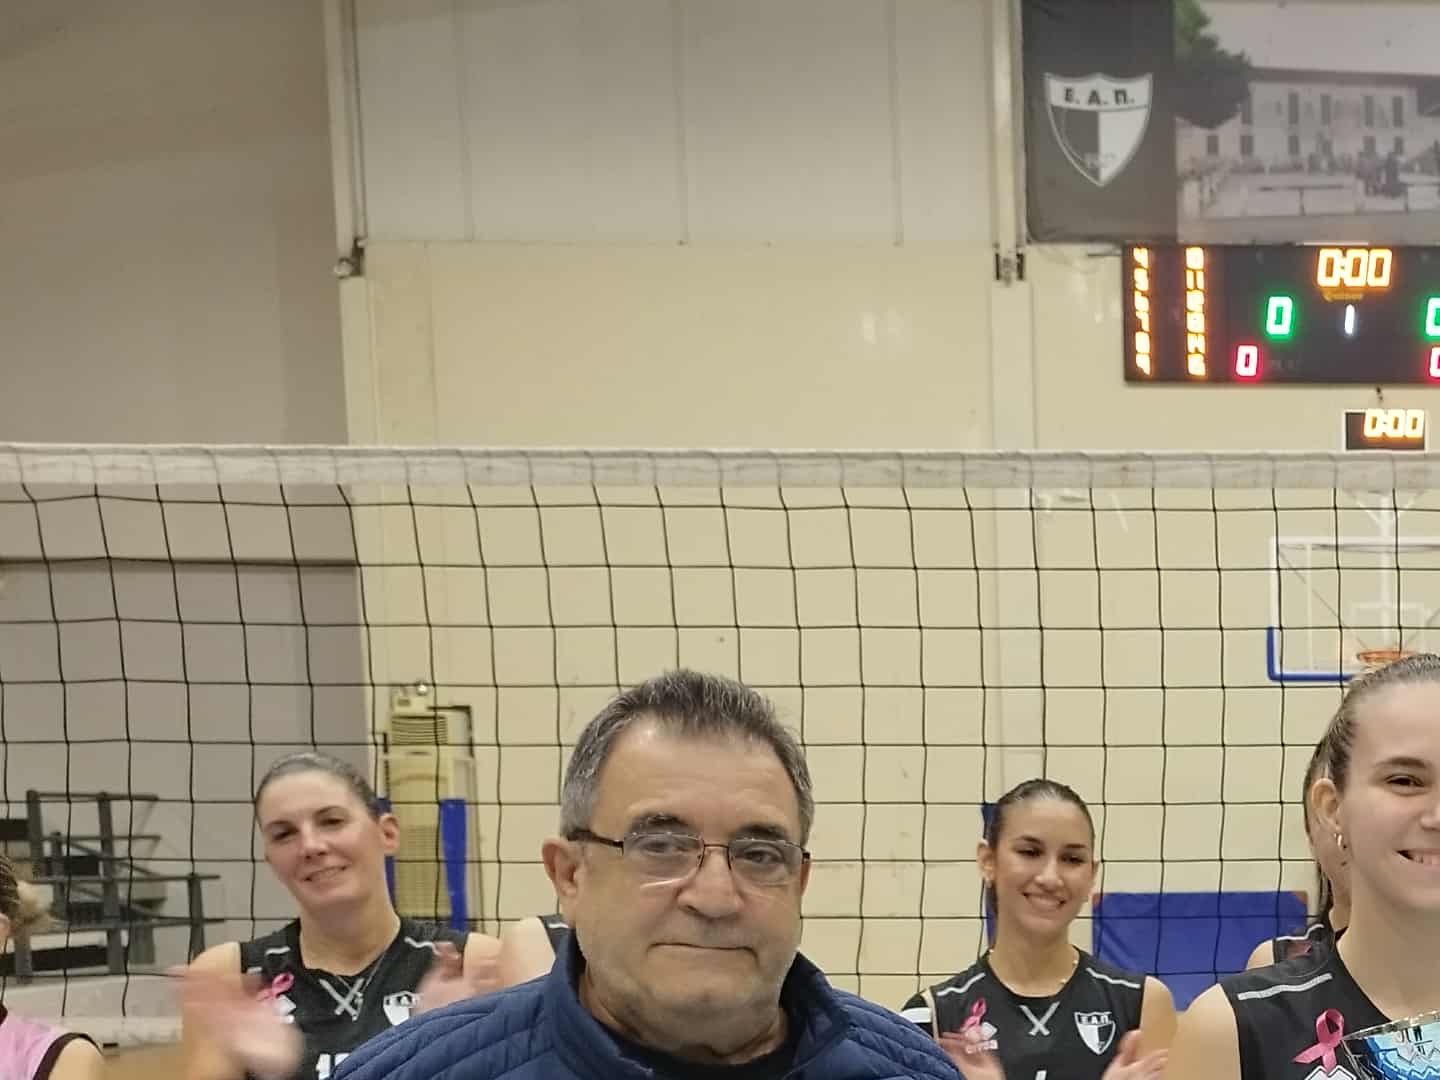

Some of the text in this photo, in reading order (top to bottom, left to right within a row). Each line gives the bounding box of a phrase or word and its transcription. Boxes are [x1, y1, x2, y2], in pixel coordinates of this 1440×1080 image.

[1316, 248, 1393, 287] 0:00
[1266, 296, 1293, 335] 0
[1345, 304, 1355, 335] 1
[1236, 345, 1258, 377] 0
[1363, 408, 1425, 438] 0:00
